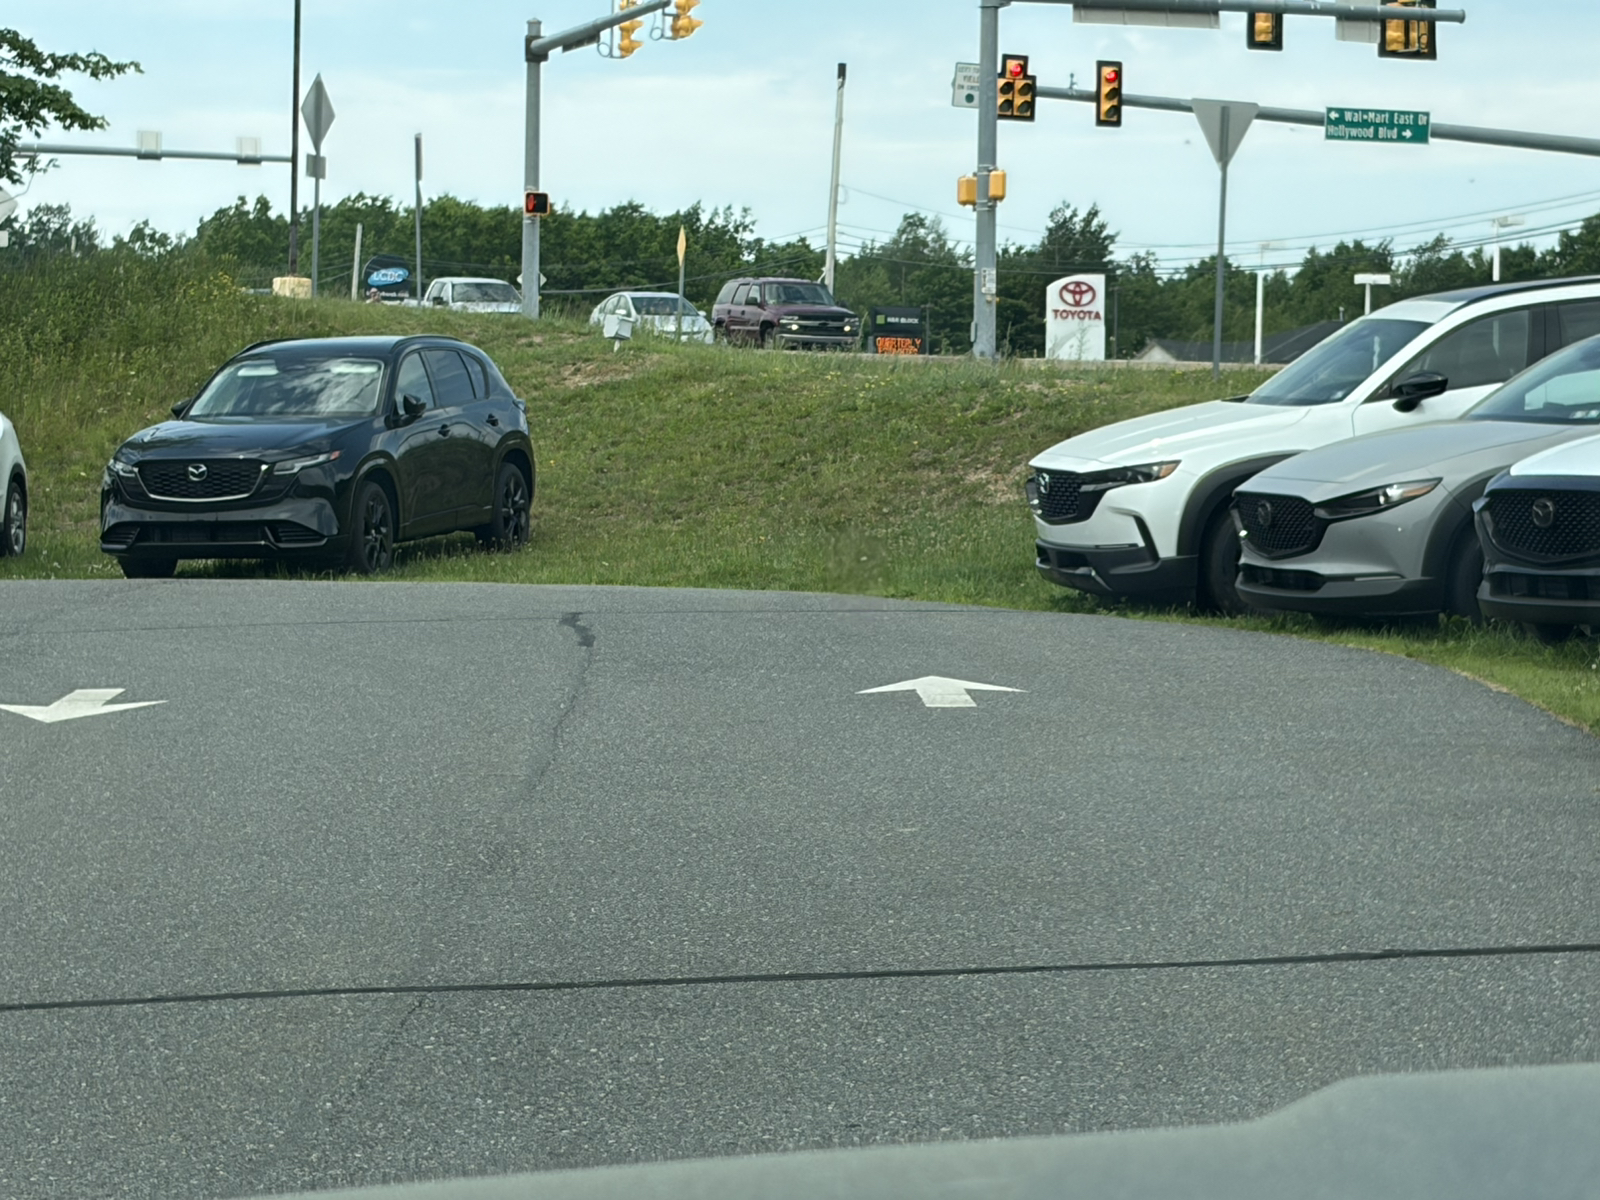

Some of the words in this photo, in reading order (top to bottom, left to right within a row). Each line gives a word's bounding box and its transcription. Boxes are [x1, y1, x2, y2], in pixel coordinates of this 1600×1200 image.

[1394, 112, 1414, 125] East
[1418, 114, 1428, 126] Dr
[1327, 125, 1374, 139] Hollywood
[1378, 127, 1398, 139] Blvd
[1052, 309, 1101, 320] TOYOTA
